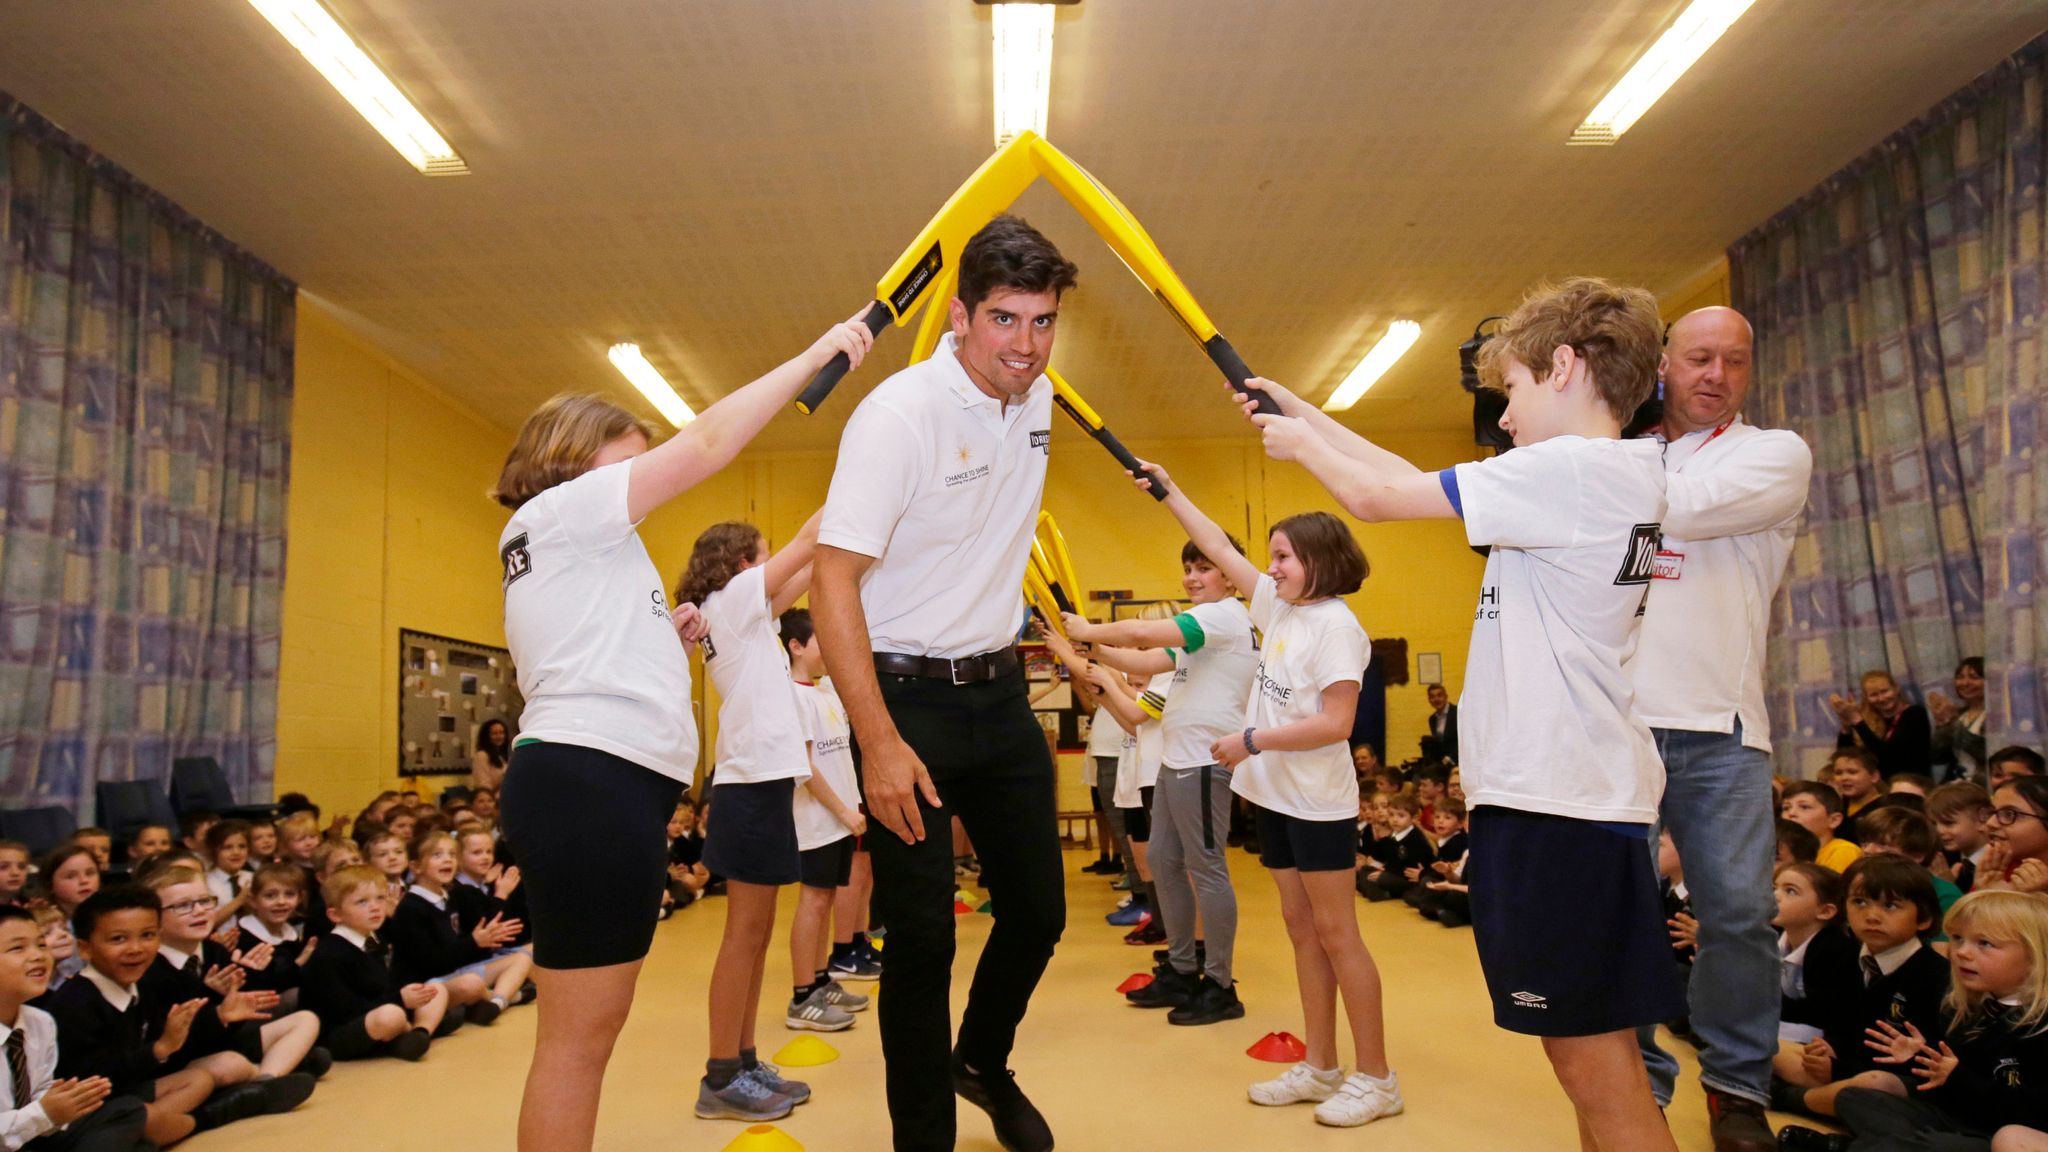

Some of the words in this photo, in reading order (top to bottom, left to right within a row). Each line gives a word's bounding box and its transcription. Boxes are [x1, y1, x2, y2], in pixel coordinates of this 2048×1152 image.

[944, 471, 968, 483] CHANCE
[968, 469, 975, 477] TO
[975, 464, 989, 475] SHINE
